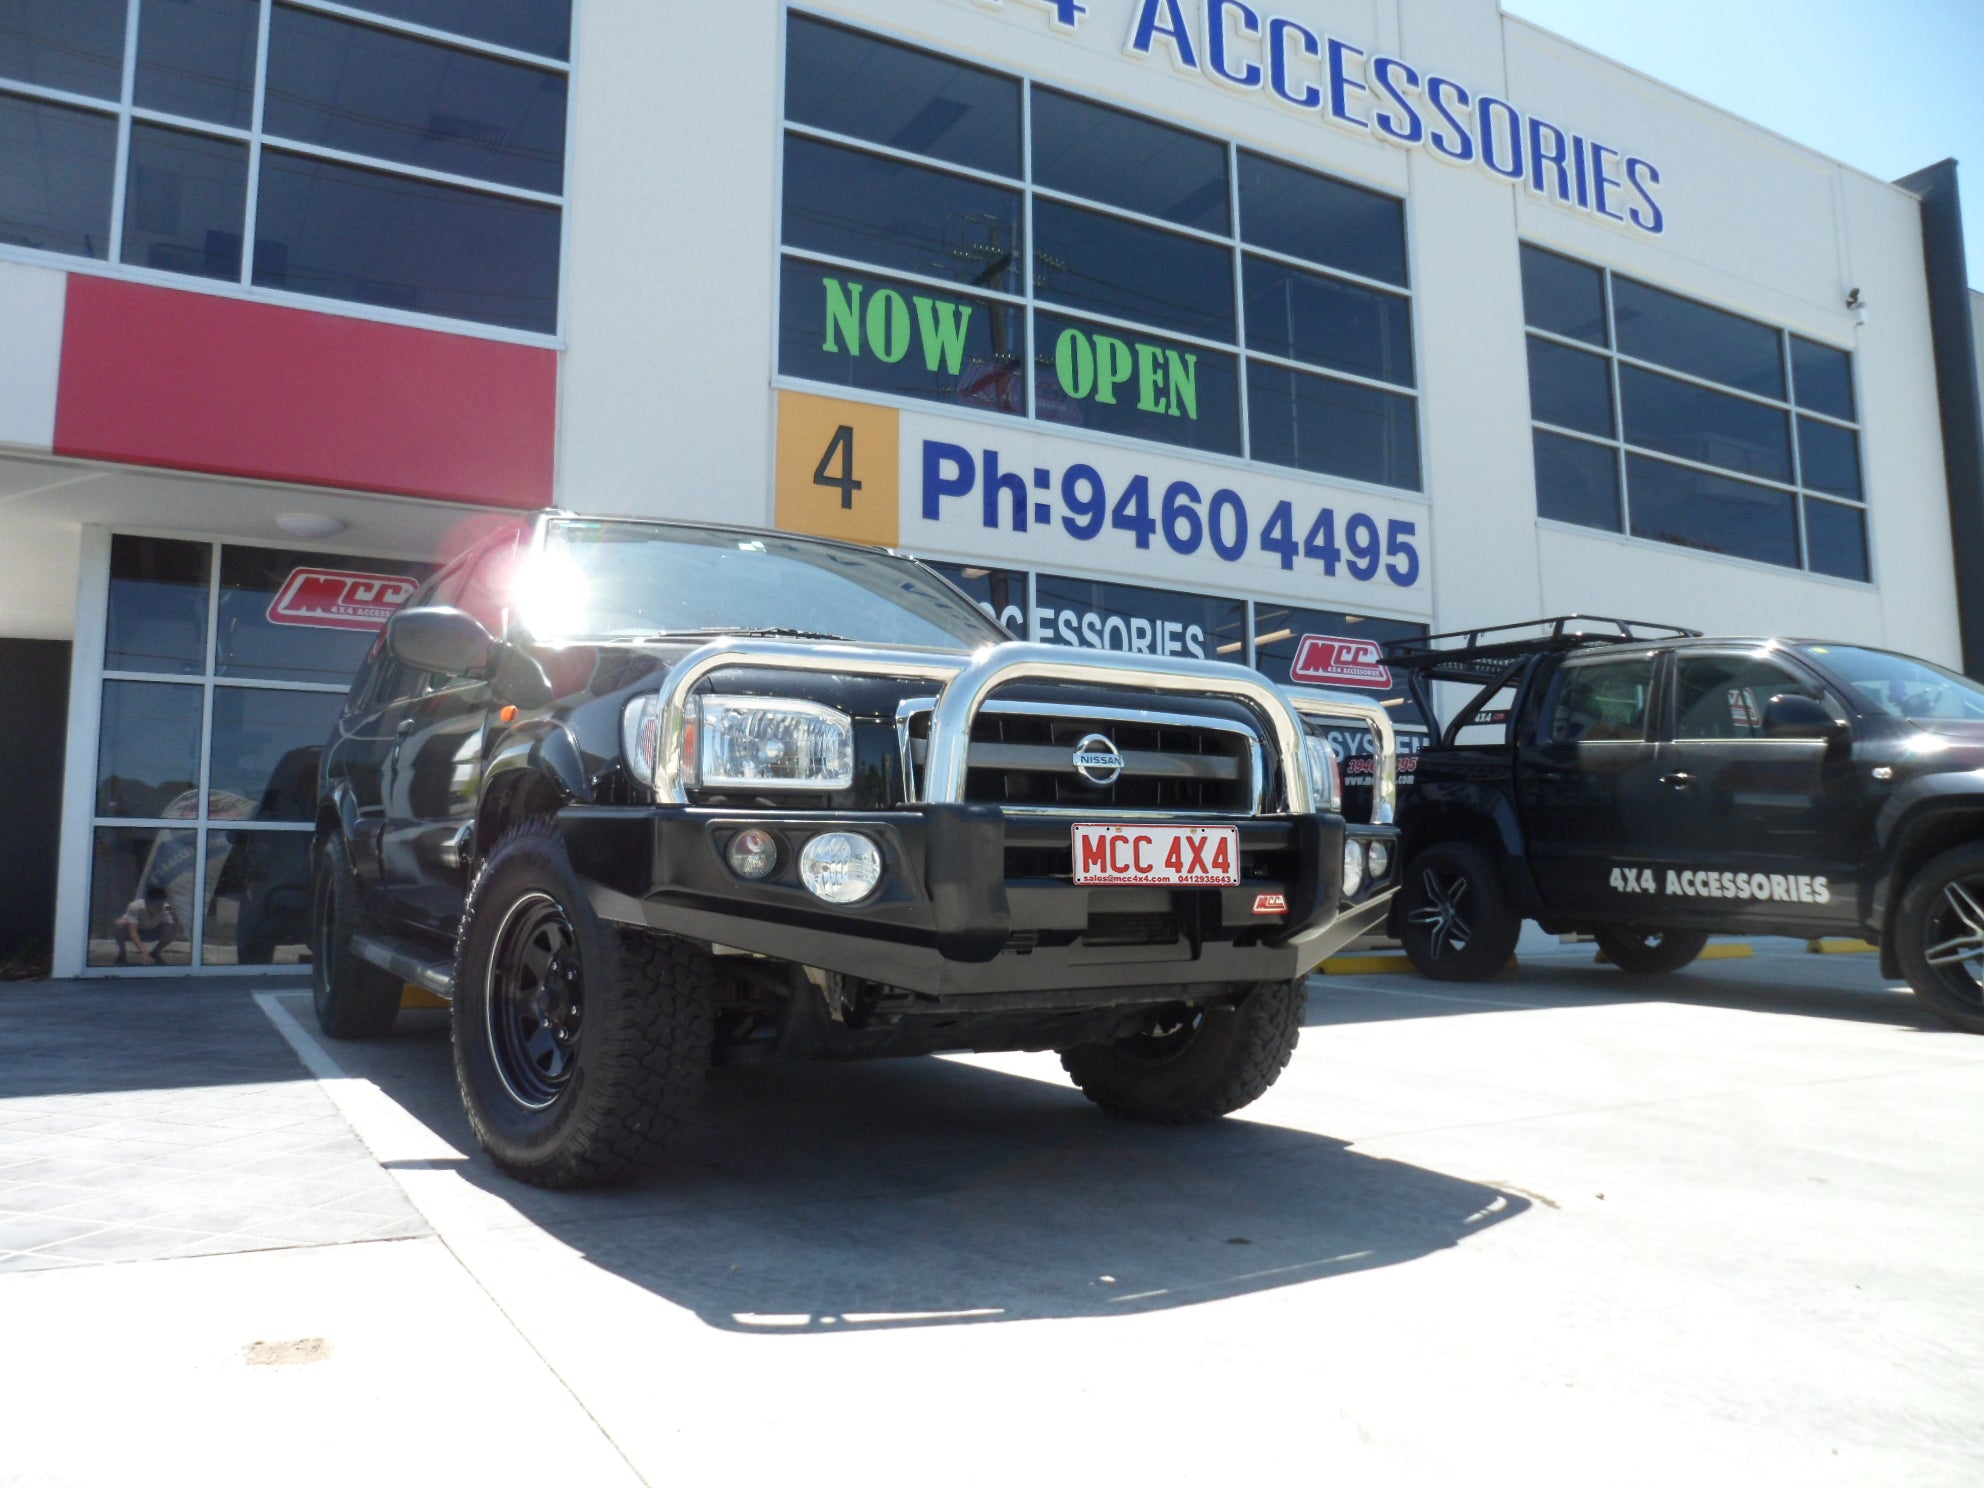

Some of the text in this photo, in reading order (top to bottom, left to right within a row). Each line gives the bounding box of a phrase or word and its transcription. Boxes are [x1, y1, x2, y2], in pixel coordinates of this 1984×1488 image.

[1132, 0, 1664, 234] ACCESSORIES
[822, 277, 972, 376] NOW
[1055, 328, 1198, 420] OPEN
[812, 424, 863, 510] 4
[282, 576, 404, 613] MCC
[1300, 641, 1380, 673] MCC
[1080, 755, 1121, 766] NISSAN
[1081, 834, 1231, 874] MCC 4X4
[1083, 874, 1232, 883] sales@mcc4x4.com 0412935643
[1609, 867, 1831, 904] 4X4 ACCESSORIES
